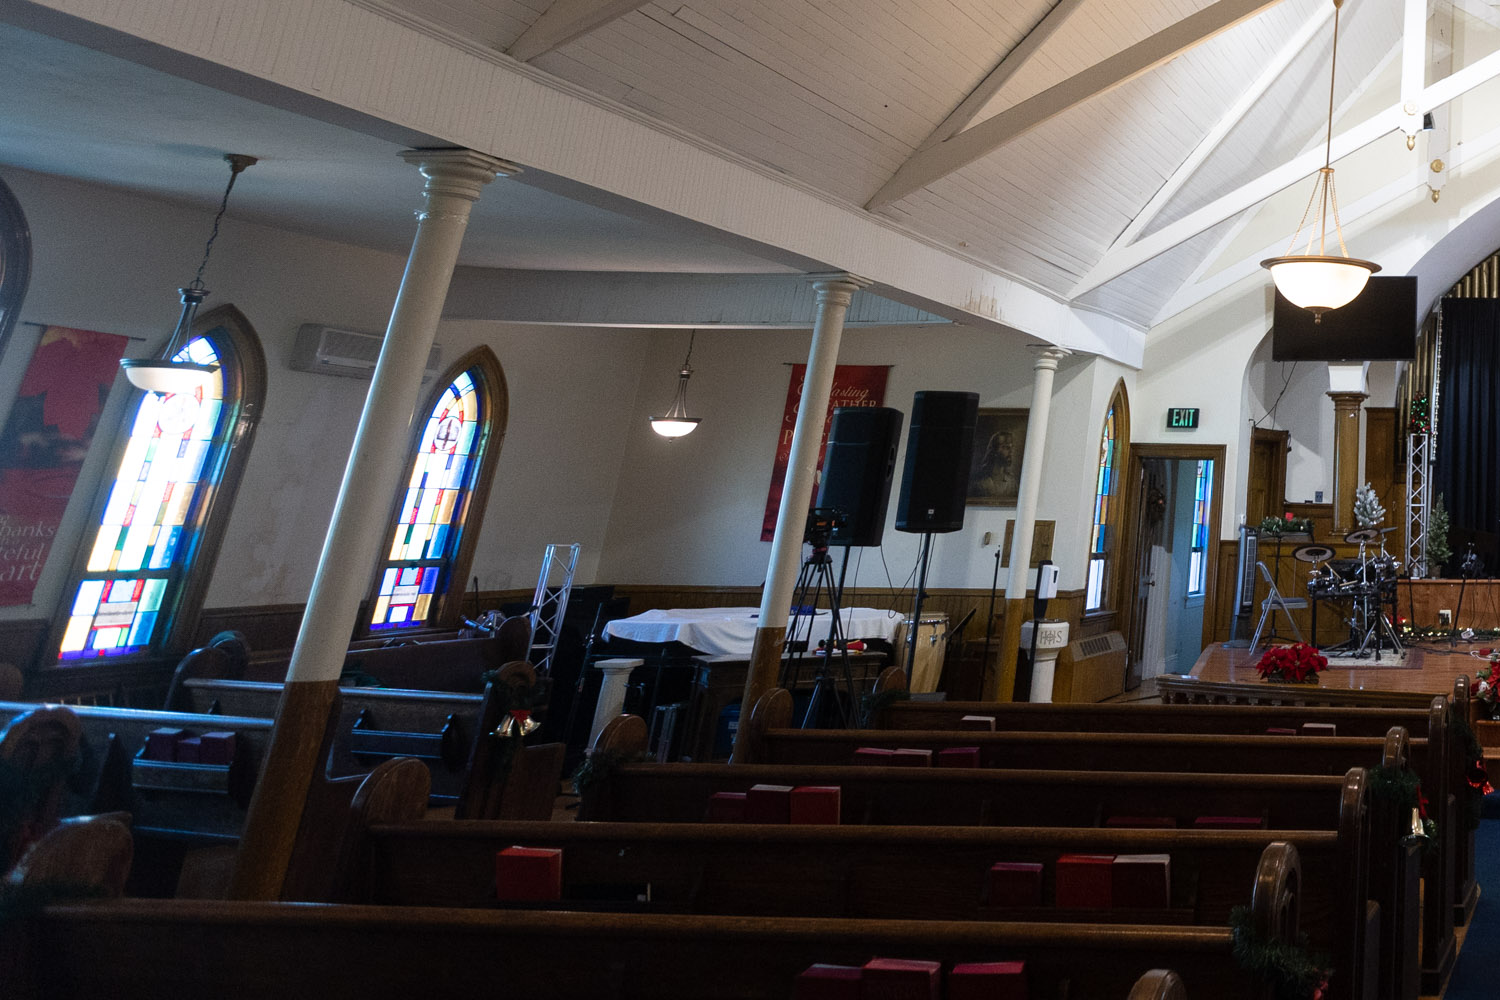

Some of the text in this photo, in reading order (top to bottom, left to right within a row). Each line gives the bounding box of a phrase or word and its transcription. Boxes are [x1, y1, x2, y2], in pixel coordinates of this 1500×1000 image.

[1172, 409, 1195, 426] EXIT
[0, 519, 55, 537] hanks
[0, 559, 42, 581] art
